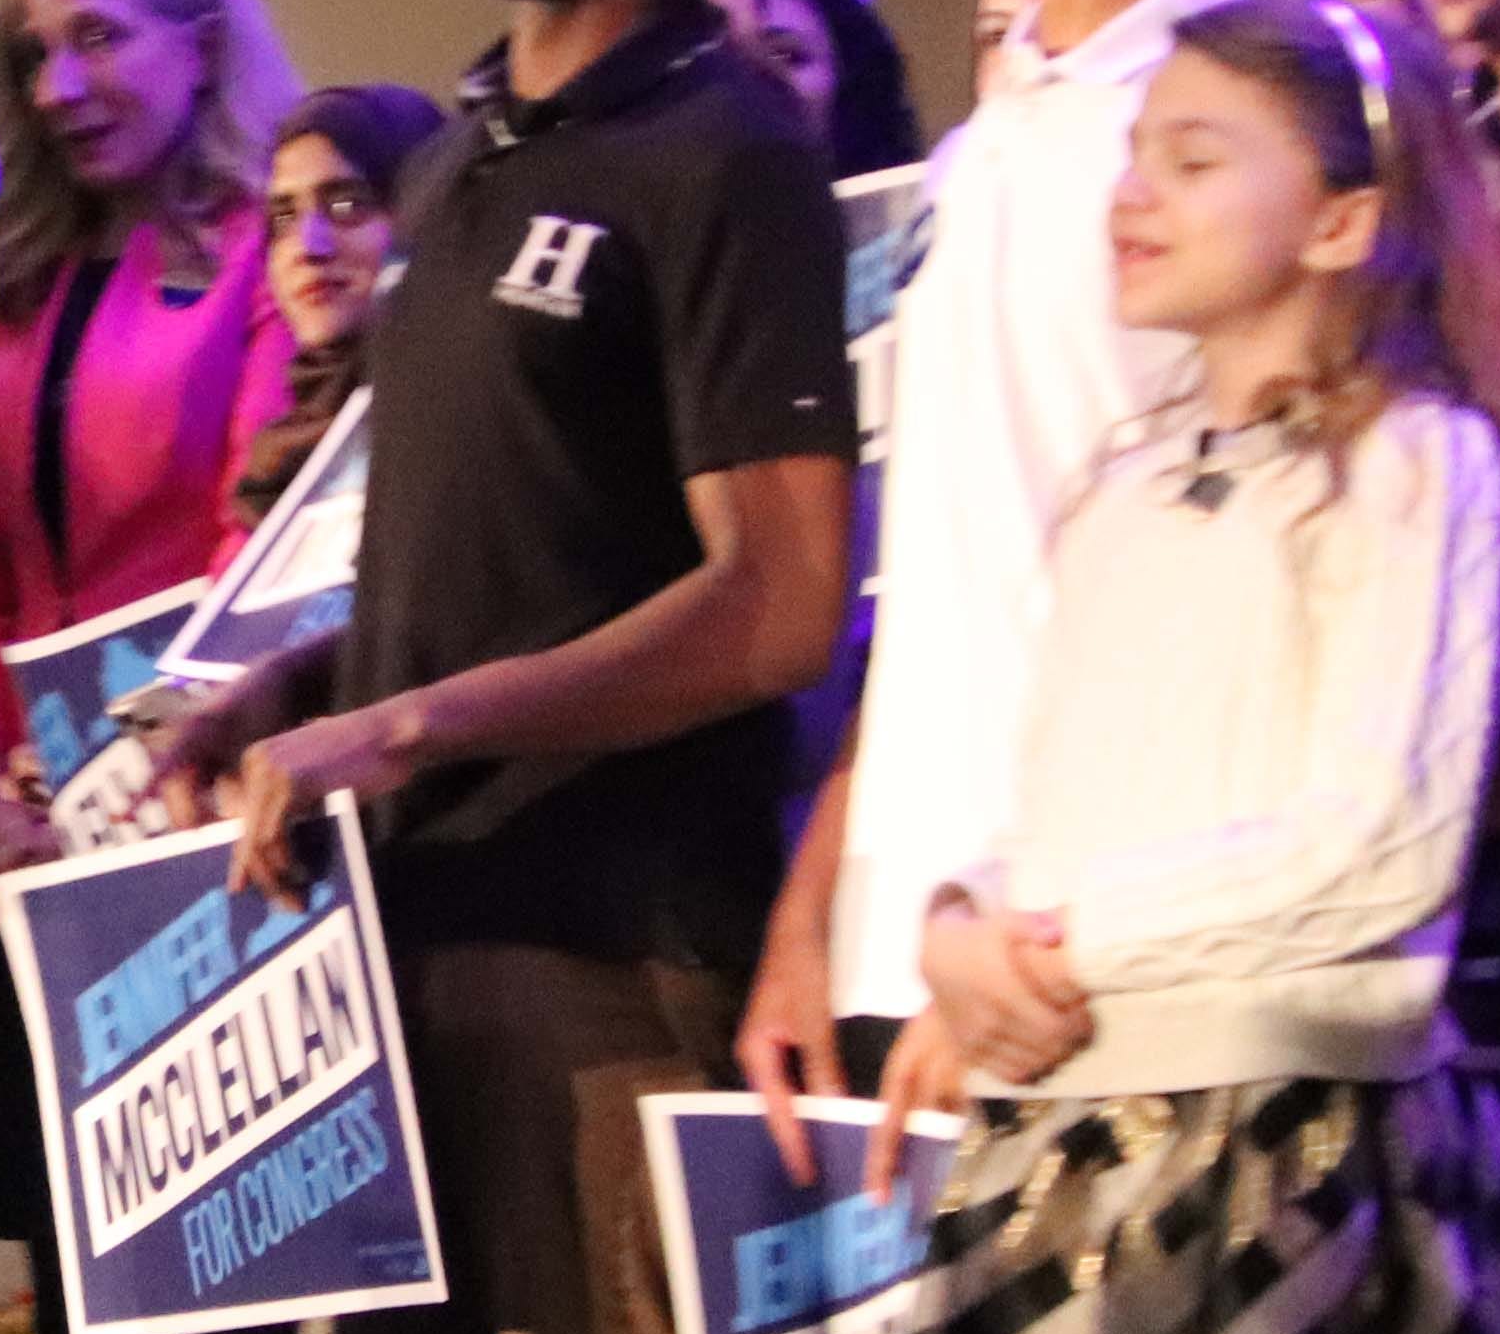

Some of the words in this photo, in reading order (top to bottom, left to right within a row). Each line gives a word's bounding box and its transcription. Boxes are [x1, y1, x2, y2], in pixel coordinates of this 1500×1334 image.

[496, 215, 610, 299] H
[78, 885, 240, 1087] JENNIFER
[90, 935, 364, 1227] MCCLELLAN
[182, 1187, 240, 1297] FOR
[236, 1087, 390, 1261] CONGRESS
